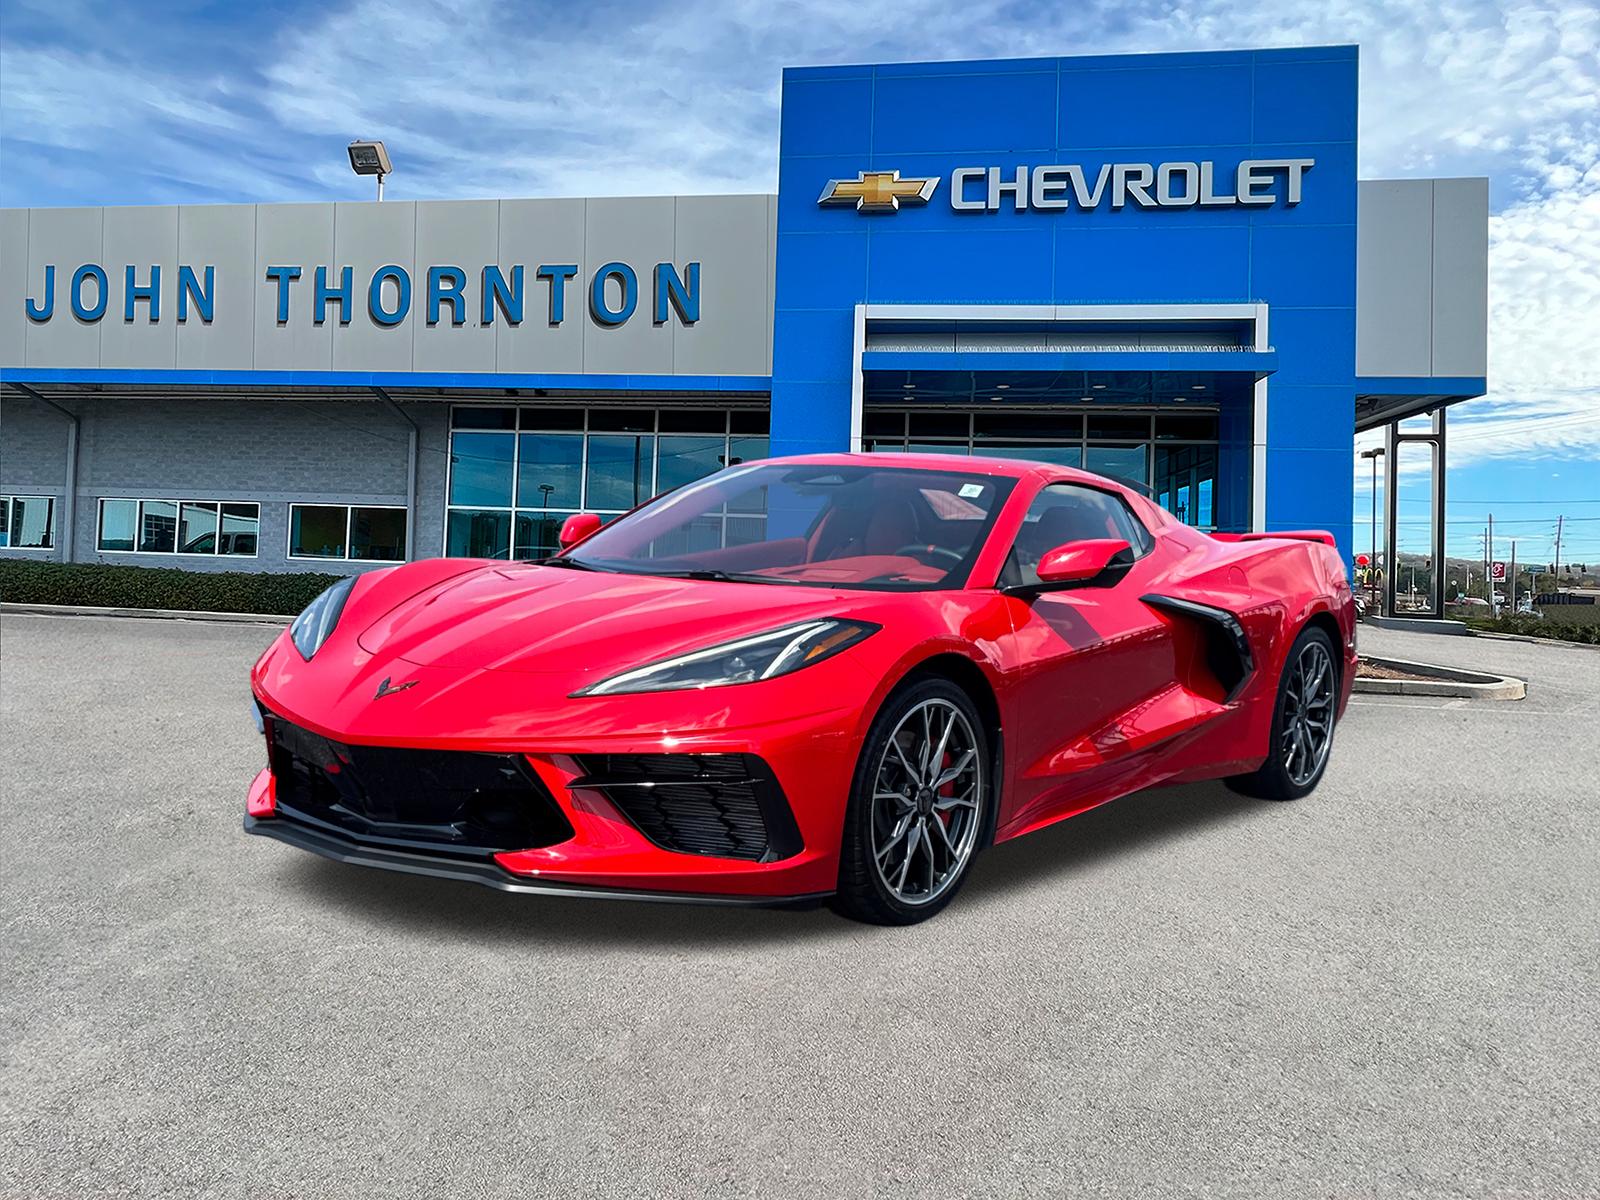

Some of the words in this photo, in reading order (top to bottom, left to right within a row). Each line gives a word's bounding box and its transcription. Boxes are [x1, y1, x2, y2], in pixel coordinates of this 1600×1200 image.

[950, 158, 1316, 210] CHEVROLET
[26, 263, 216, 323] JOHN
[265, 261, 702, 328] THORNTON
